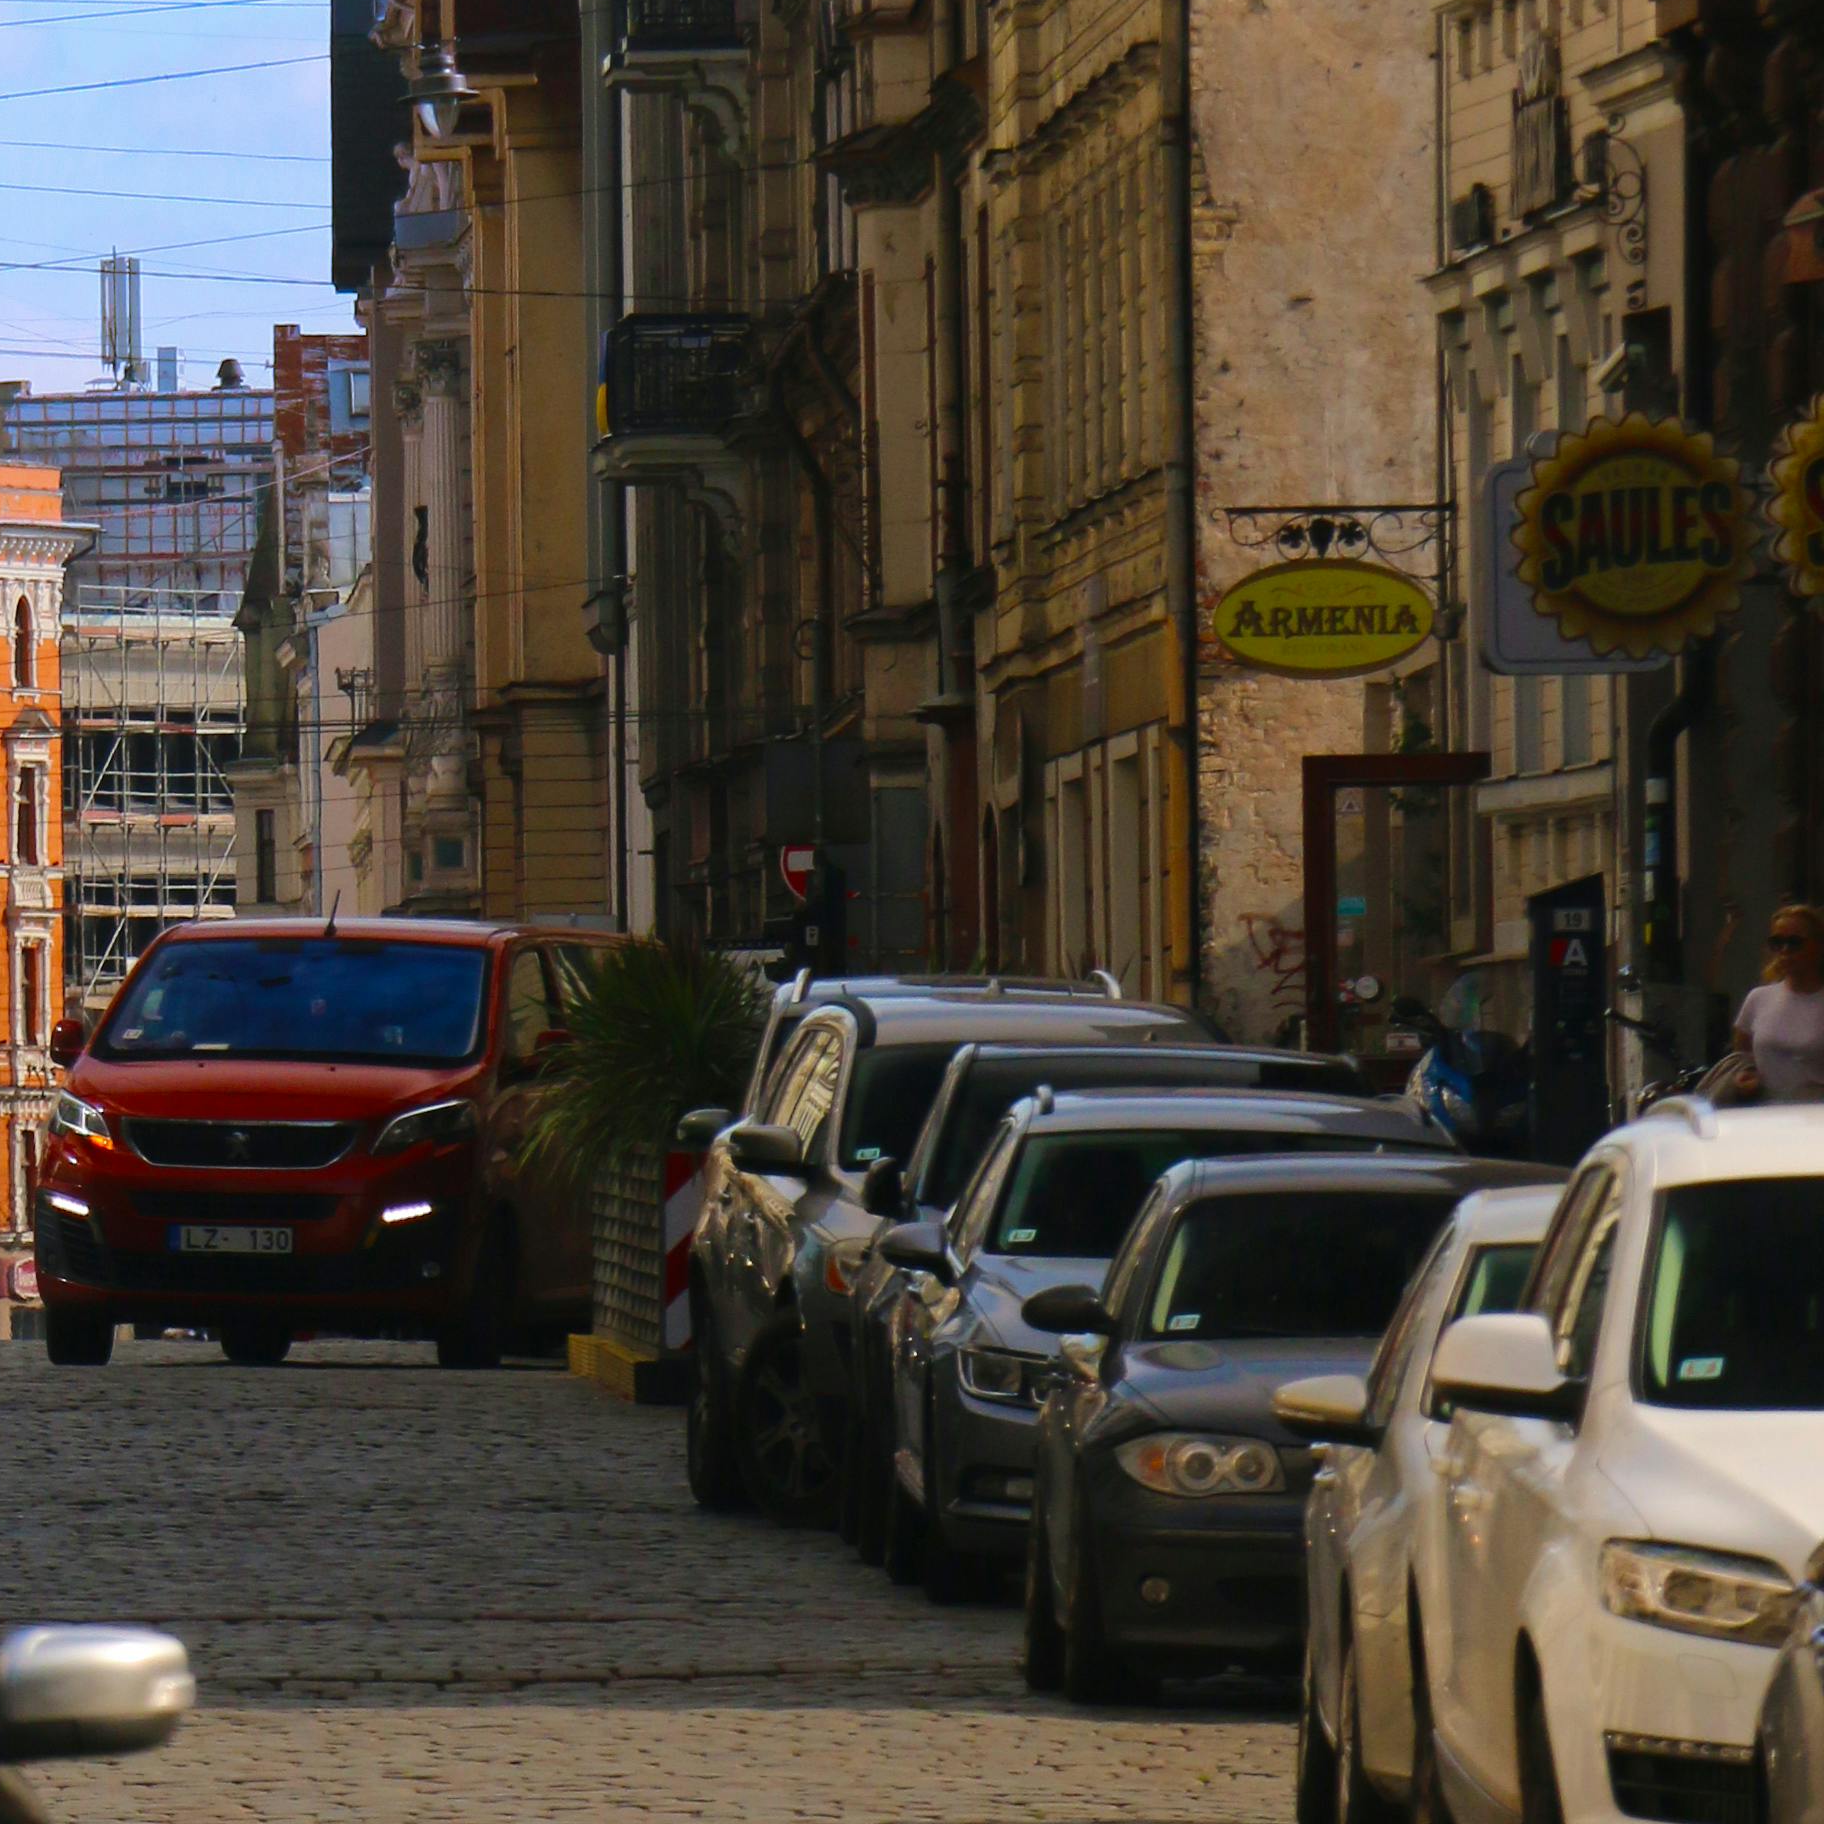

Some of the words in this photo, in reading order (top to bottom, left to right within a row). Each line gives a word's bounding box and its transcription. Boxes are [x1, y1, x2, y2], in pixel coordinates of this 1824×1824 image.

[1541, 481, 1732, 593] SAULES
[1228, 600, 1421, 639] ARMENIA
[250, 1229, 290, 1251] 130
